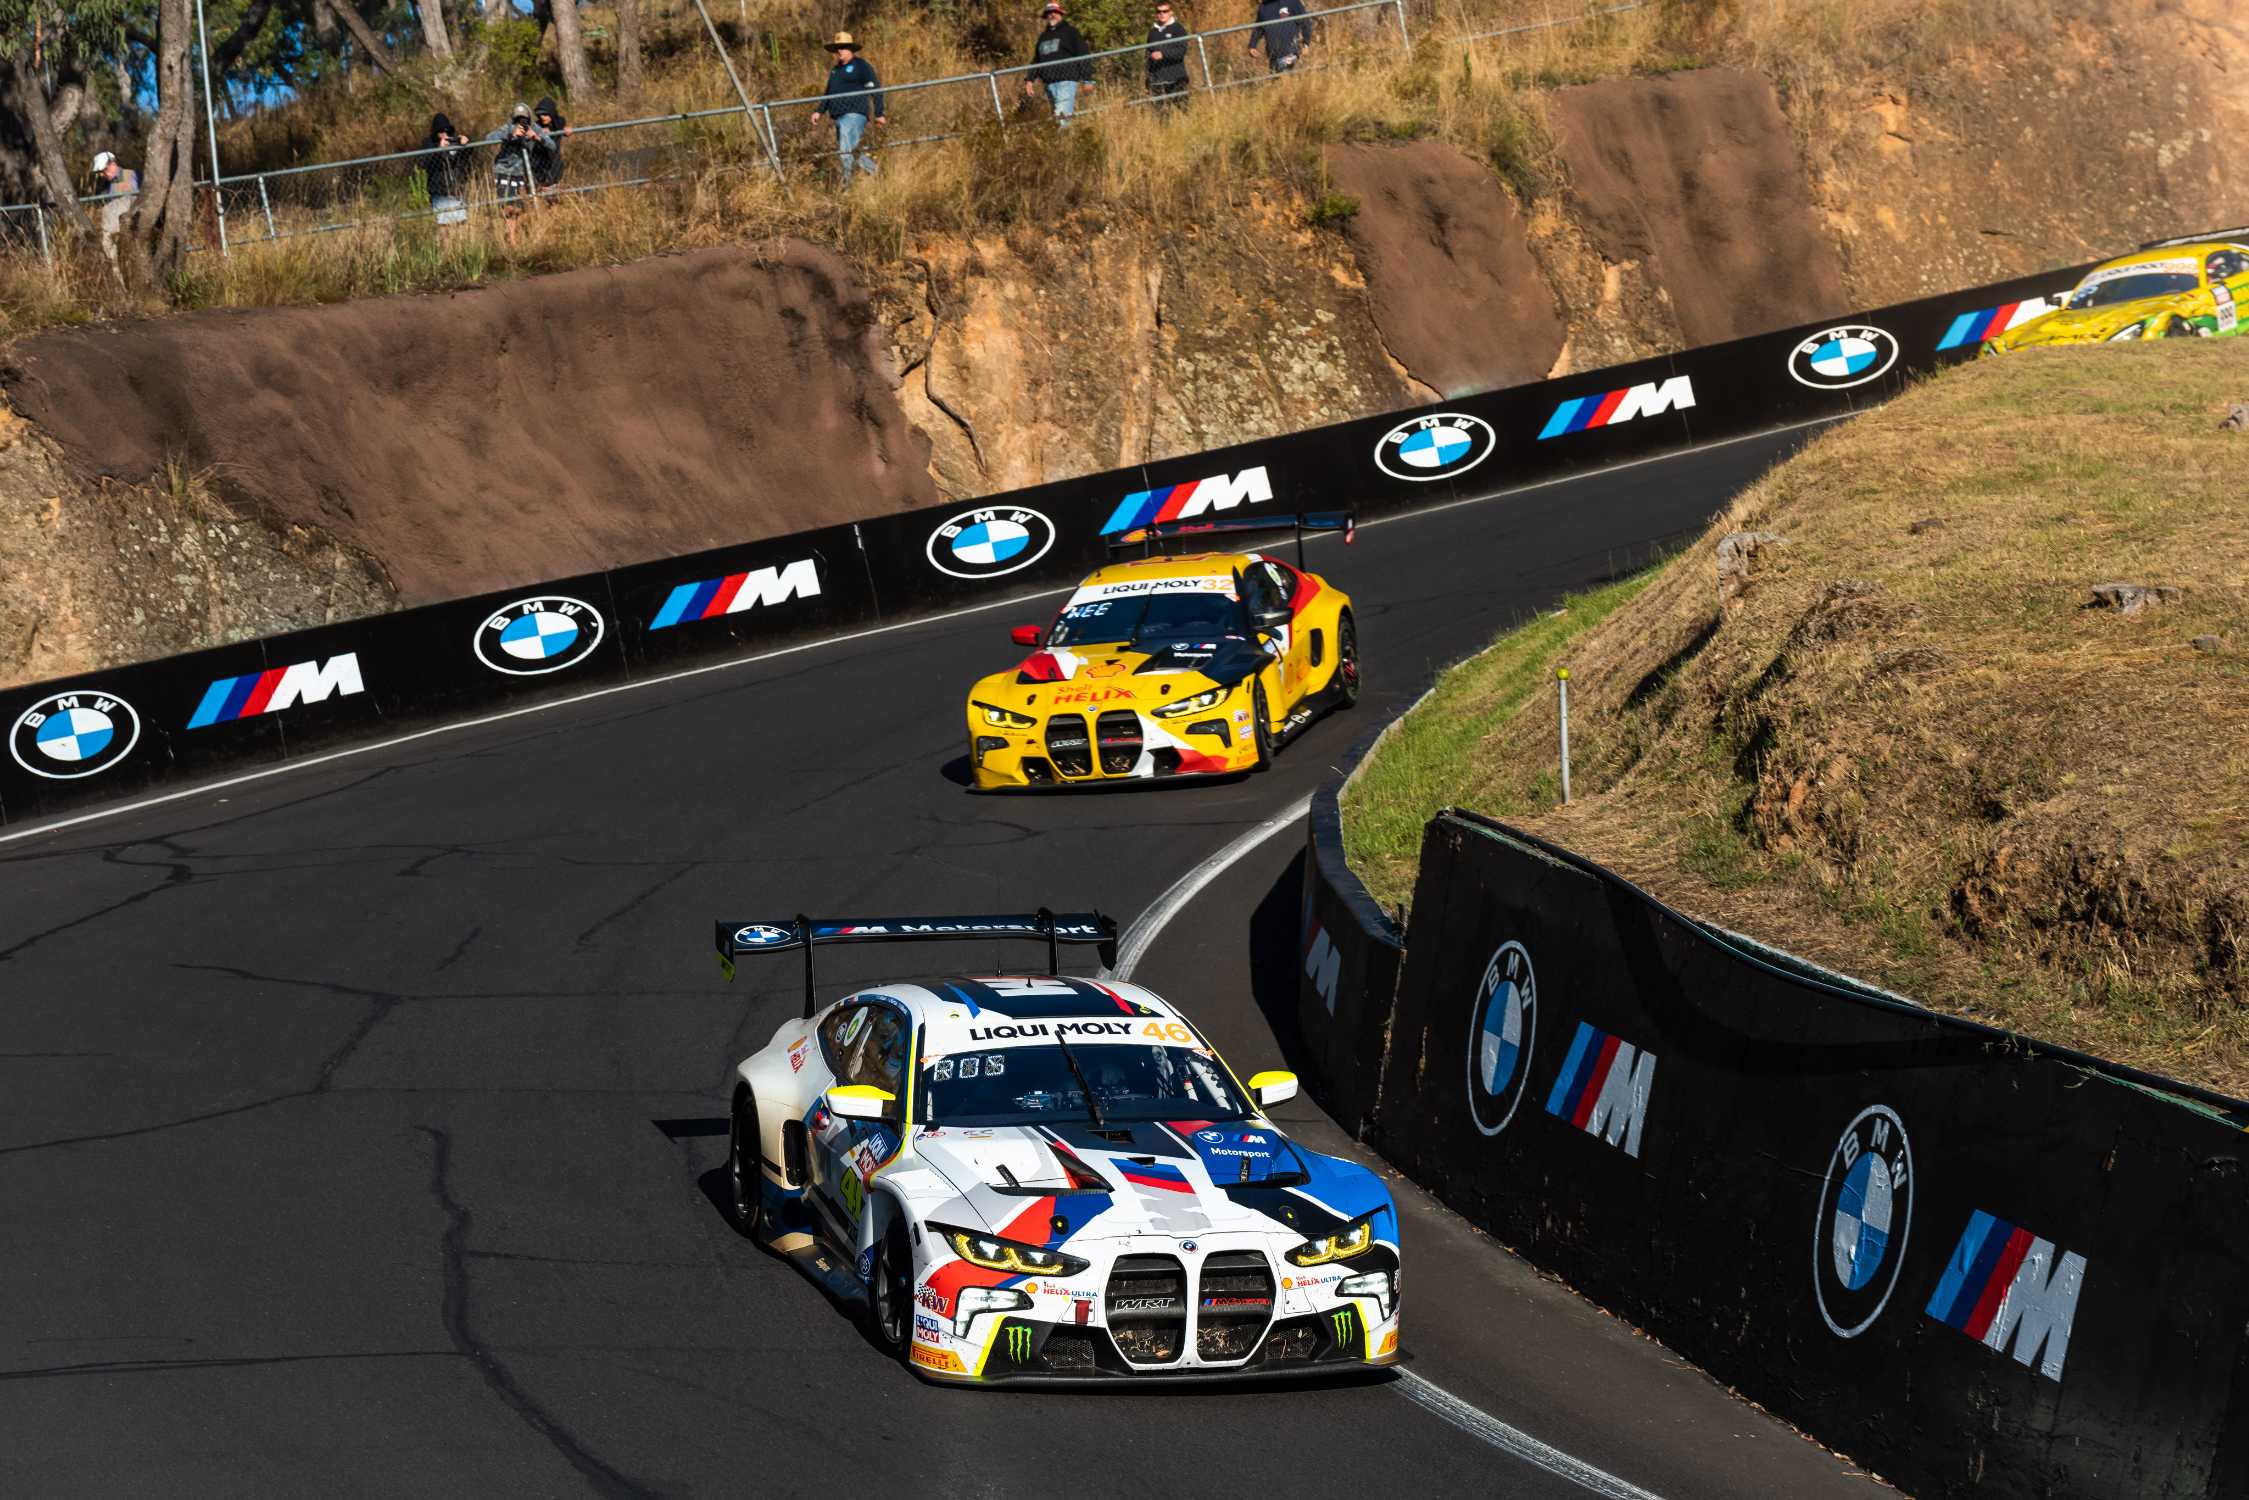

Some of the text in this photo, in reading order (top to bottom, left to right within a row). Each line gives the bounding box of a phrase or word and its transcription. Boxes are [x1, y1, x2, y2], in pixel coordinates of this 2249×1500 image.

[1800, 328, 1881, 354] BMW
[1388, 417, 1479, 445] BMW
[940, 510, 1034, 539] BMW
[1103, 579, 1233, 594] LIQUI MOLY 32
[489, 601, 583, 631] BMW
[1054, 687, 1136, 704] HELIX
[24, 696, 118, 729] BMW
[1488, 952, 1532, 1011] BMW
[970, 1022, 1193, 1043] LIQUI MOLY 46
[1210, 1147, 1271, 1158] Motorsport
[1843, 1117, 1908, 1190] BMW
[1043, 1288, 1071, 1296] HELIX
[917, 1328, 939, 1342] MOLY
